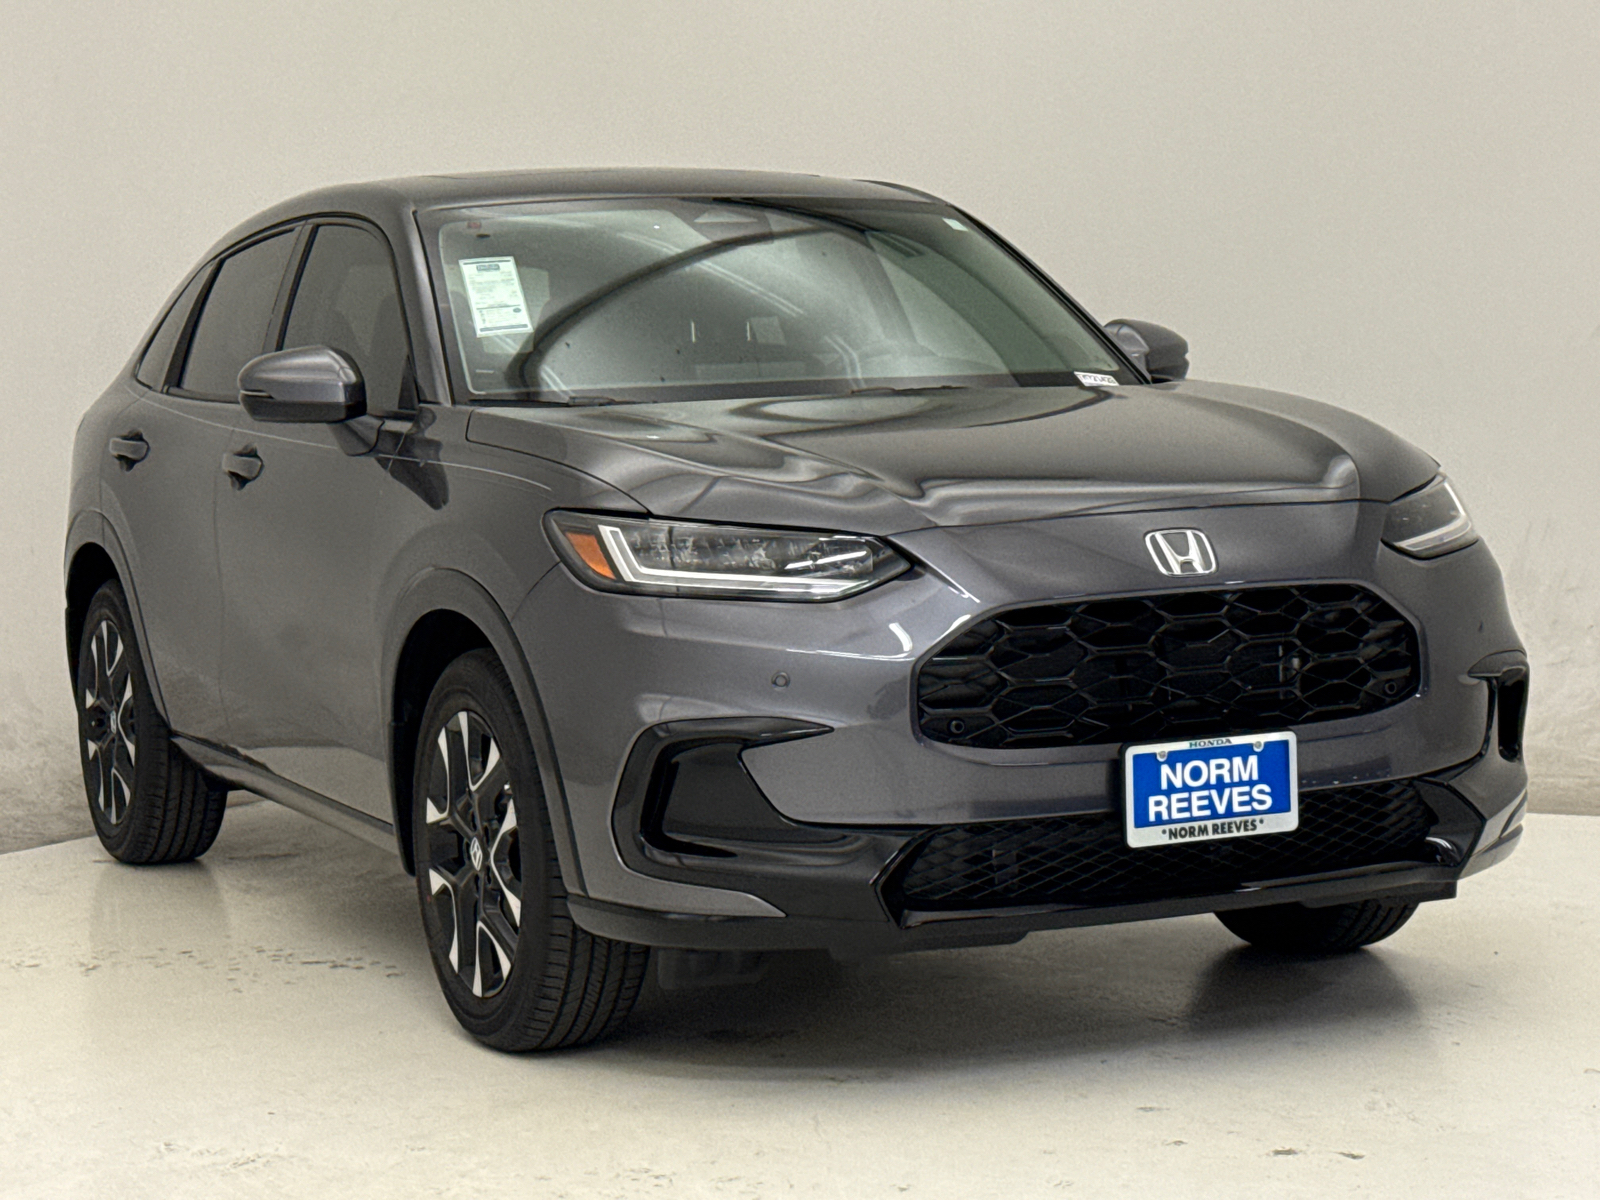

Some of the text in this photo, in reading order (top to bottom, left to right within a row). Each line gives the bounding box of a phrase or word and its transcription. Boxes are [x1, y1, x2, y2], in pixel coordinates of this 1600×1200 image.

[1189, 738, 1232, 748] HONDA
[1160, 755, 1258, 790] NORM
[1148, 784, 1273, 822] REEVES
[1168, 819, 1257, 840] NORM REEVES
